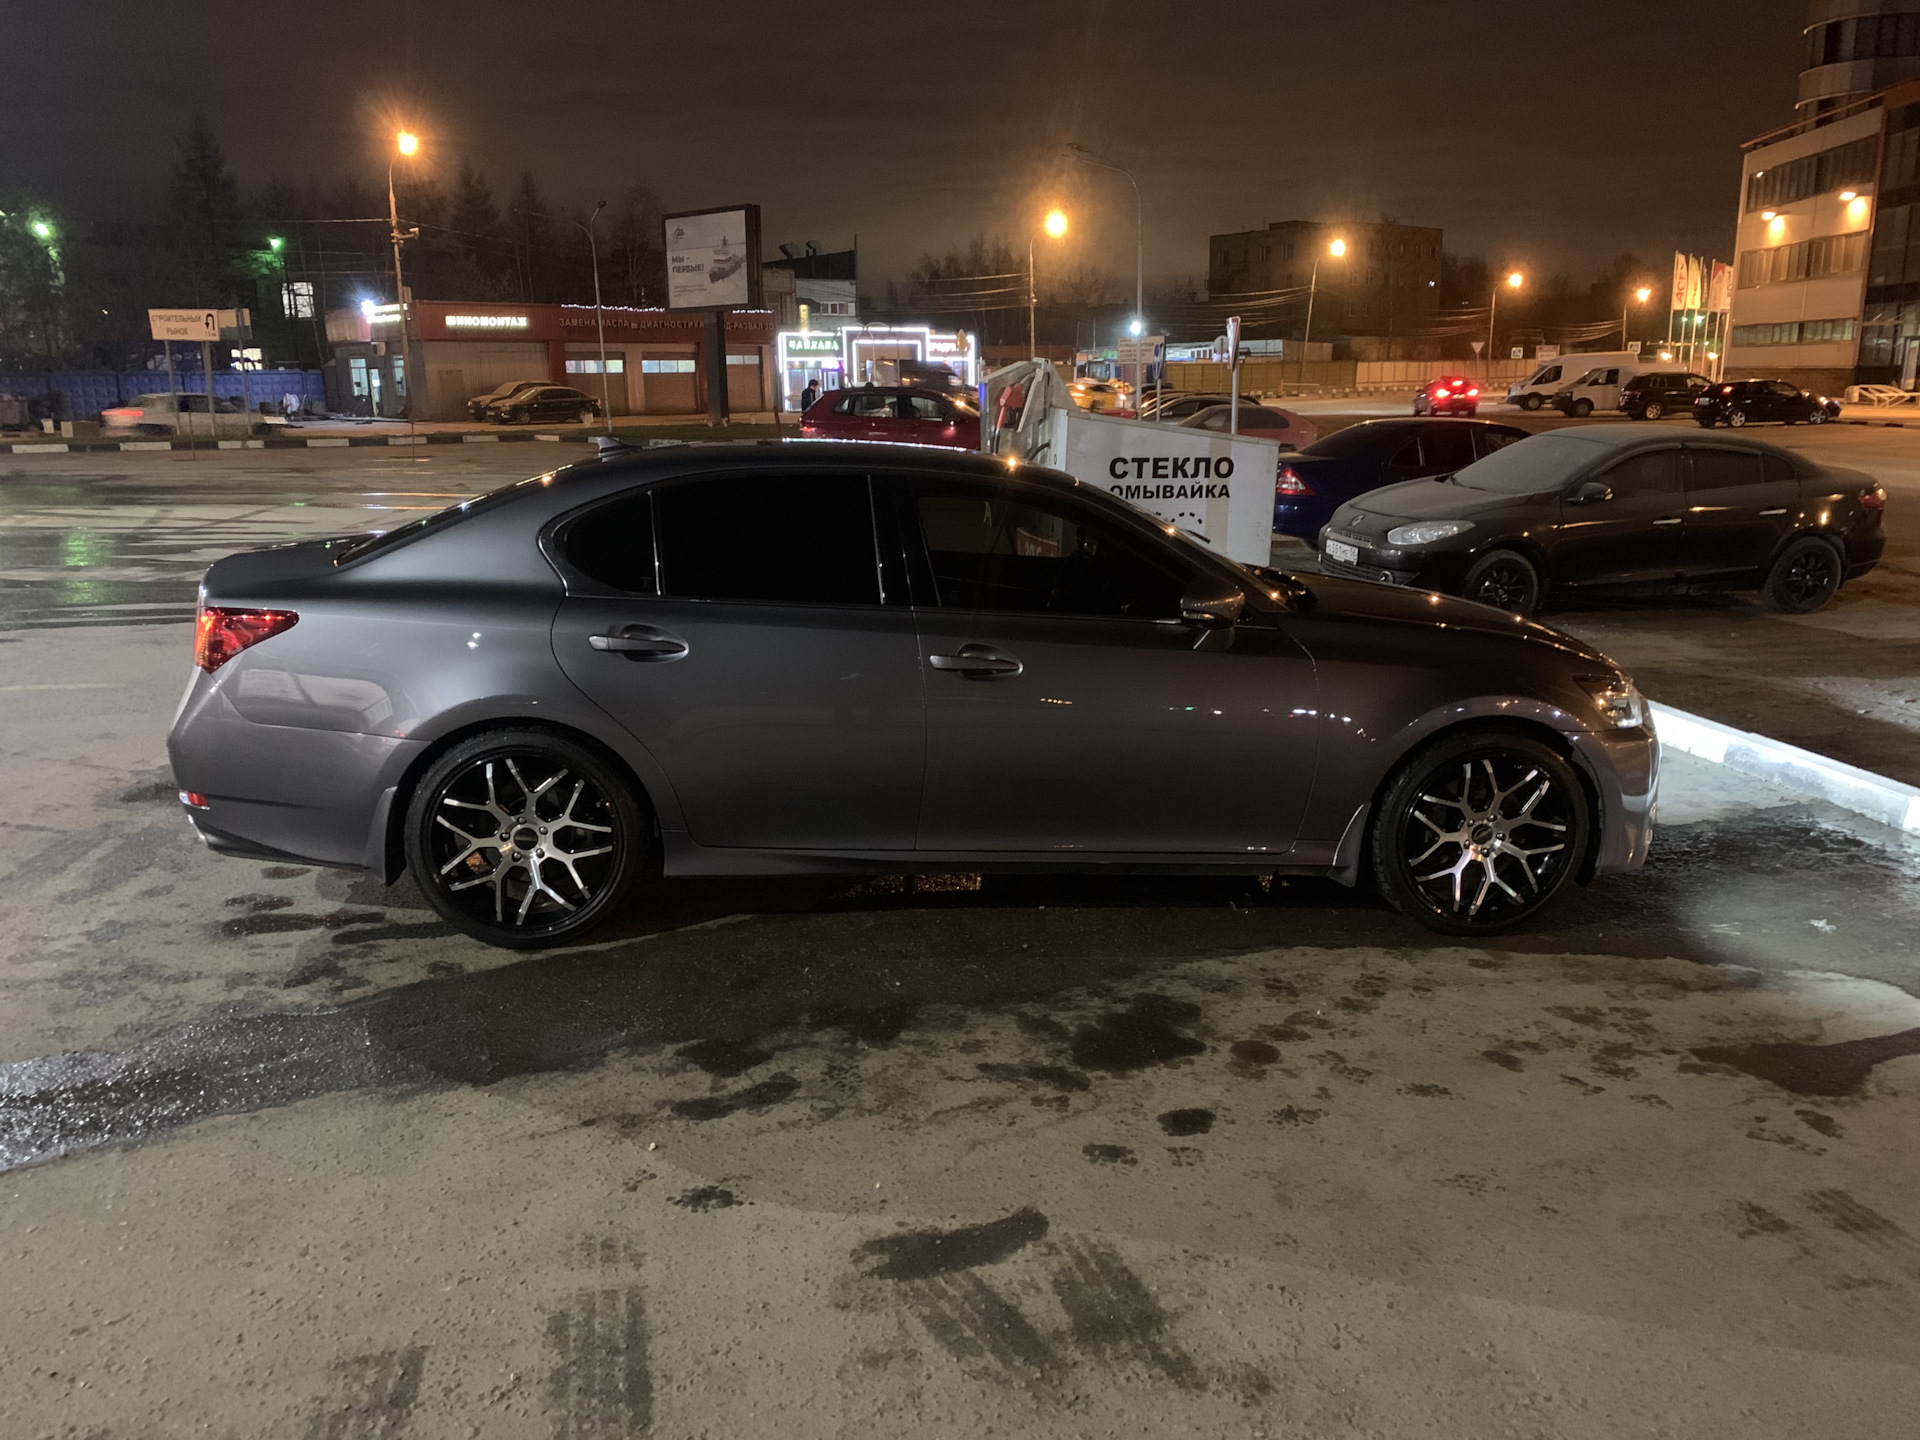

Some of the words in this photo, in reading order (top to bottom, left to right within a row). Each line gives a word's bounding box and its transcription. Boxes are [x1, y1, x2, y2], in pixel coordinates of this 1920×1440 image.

[672, 264, 705, 273] ПЕРВЫЕ!
[151, 314, 201, 323] СТРОИТЕЛЬНЫЙ
[445, 315, 528, 327] ШИНОМОНТАЖ
[559, 318, 596, 327] ЗАМЕНА
[640, 320, 705, 329] ДИАГНОСТИКА
[166, 327, 188, 336] РЫНОК
[788, 338, 839, 350] ЧАЙХАНА
[1109, 457, 1234, 479] СТЕКЛО
[1110, 481, 1231, 499] ОМЫВАЙКА
